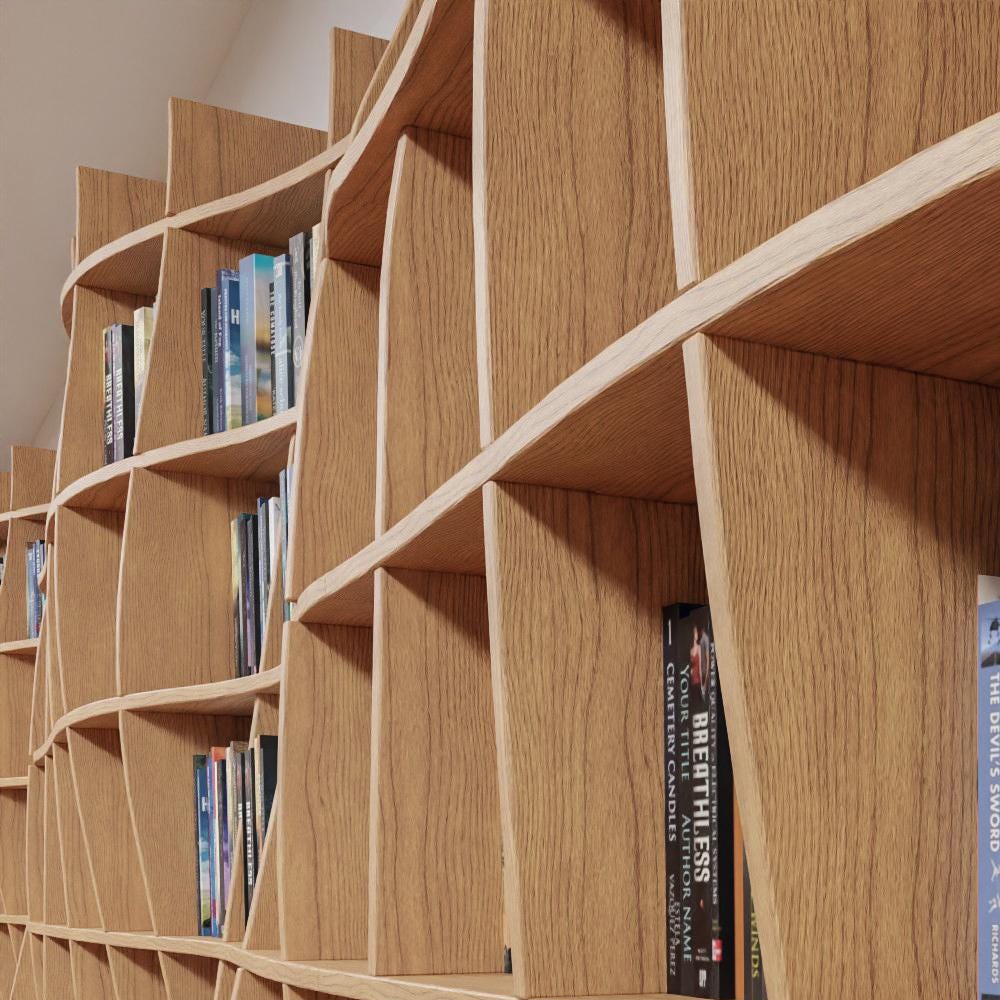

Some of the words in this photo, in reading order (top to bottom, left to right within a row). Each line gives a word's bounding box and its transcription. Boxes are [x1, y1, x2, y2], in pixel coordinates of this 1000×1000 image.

[666, 662, 677, 756] CEMETERY
[679, 664, 691, 724] YOUR
[989, 671, 1000, 705] THE
[680, 732, 690, 783] TITLE
[989, 710, 1000, 778] DEVIL'S
[667, 759, 677, 842] CANDLES
[692, 711, 711, 883] BREATHLESS
[989, 783, 1000, 852] SWORD
[681, 814, 692, 900] AUTHOR
[682, 906, 693, 963] NAME
[990, 924, 1000, 984] RICHARDS
